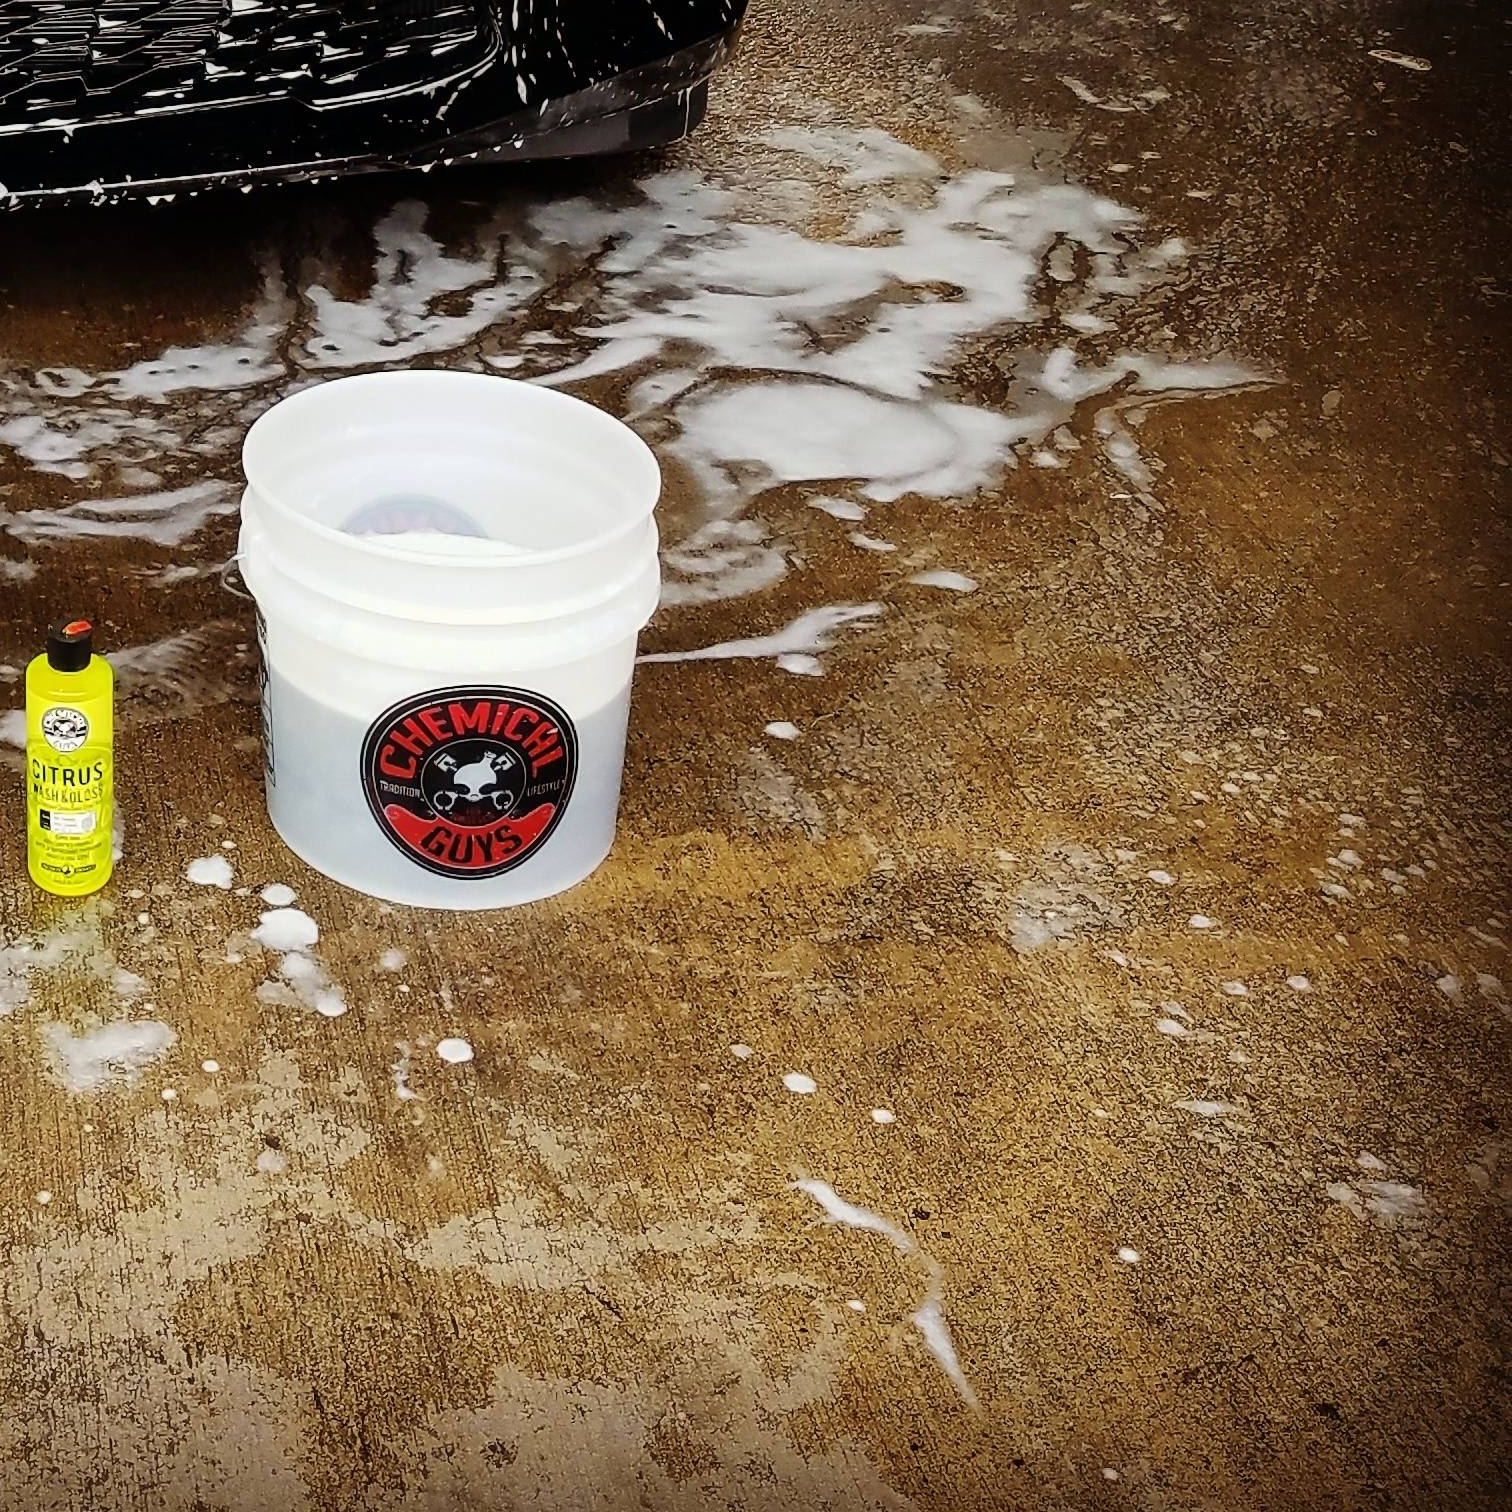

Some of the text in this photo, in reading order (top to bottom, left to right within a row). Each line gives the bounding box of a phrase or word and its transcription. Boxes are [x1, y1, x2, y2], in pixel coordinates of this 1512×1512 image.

[380, 701, 564, 780] CHEMICAL
[32, 759, 103, 787] CITRUS
[379, 780, 420, 798] TRADITION
[421, 824, 522, 864] GUYS
